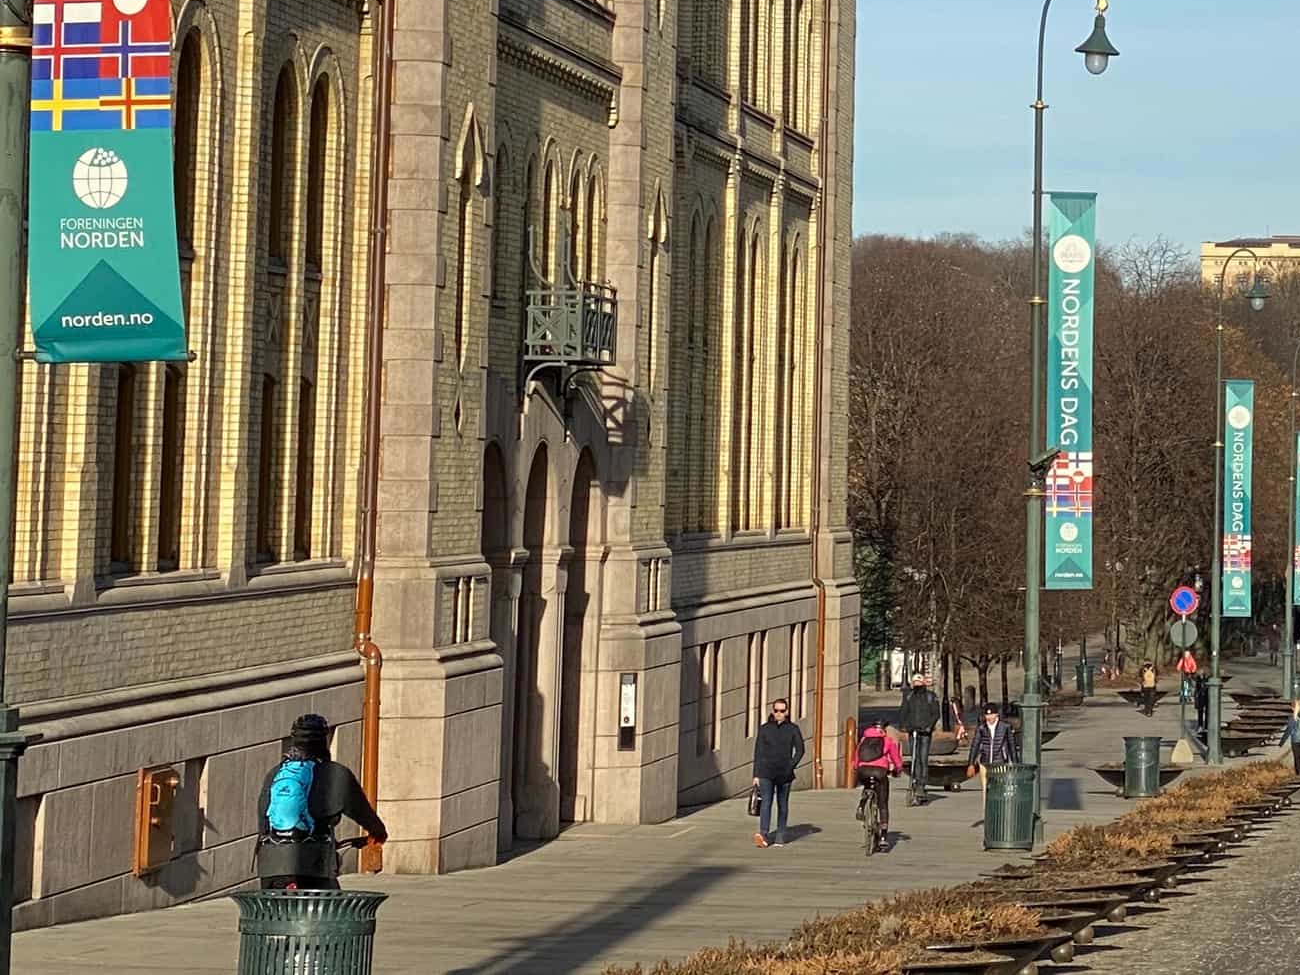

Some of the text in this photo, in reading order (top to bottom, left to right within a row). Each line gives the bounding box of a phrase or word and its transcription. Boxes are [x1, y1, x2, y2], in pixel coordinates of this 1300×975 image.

[60, 217, 144, 230] FORENINGEN
[60, 231, 144, 249] NORDEN
[61, 312, 153, 328] norden.no
[1059, 278, 1080, 389] NORDENS
[1059, 397, 1079, 446] DAG
[1232, 432, 1245, 532] NORDENS DAG
